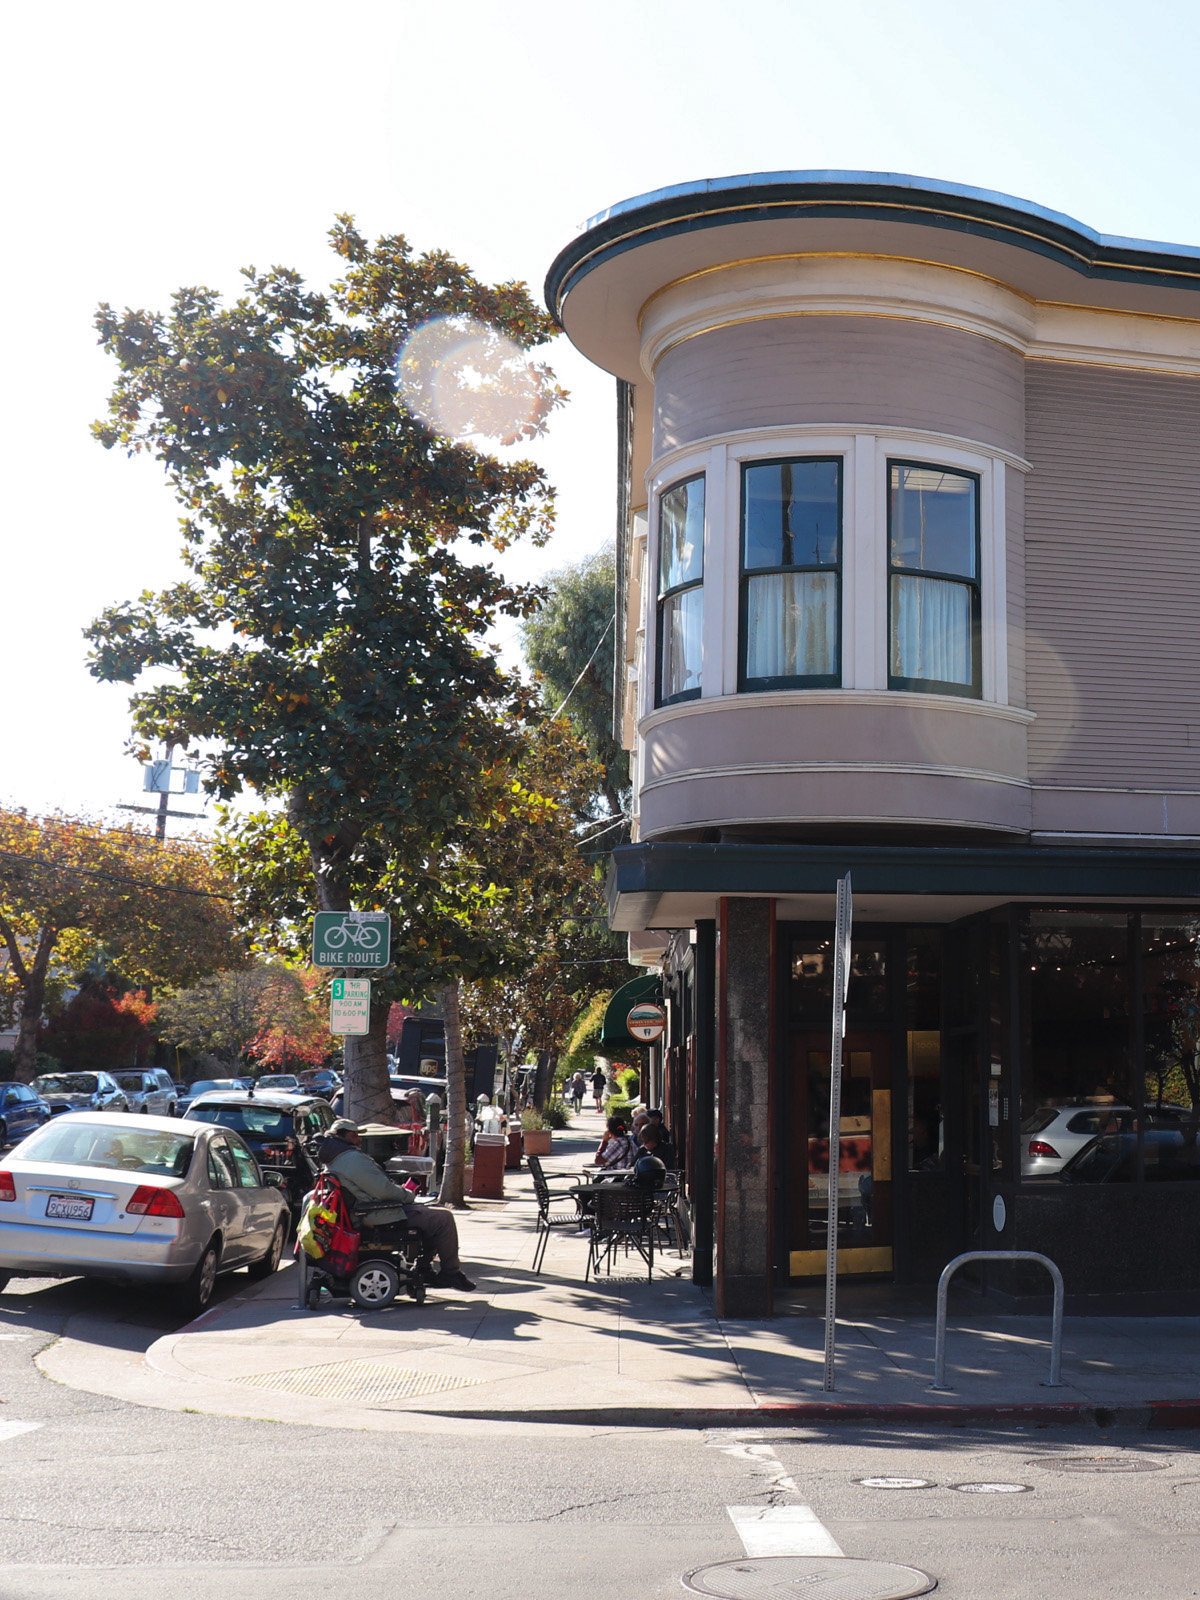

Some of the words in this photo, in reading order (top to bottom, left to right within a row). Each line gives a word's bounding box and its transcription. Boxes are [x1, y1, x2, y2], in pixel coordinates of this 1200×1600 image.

[319, 952, 344, 963] BIKE
[347, 952, 382, 963] ROUTE
[334, 982, 342, 997] 3
[421, 1064, 437, 1075] ups
